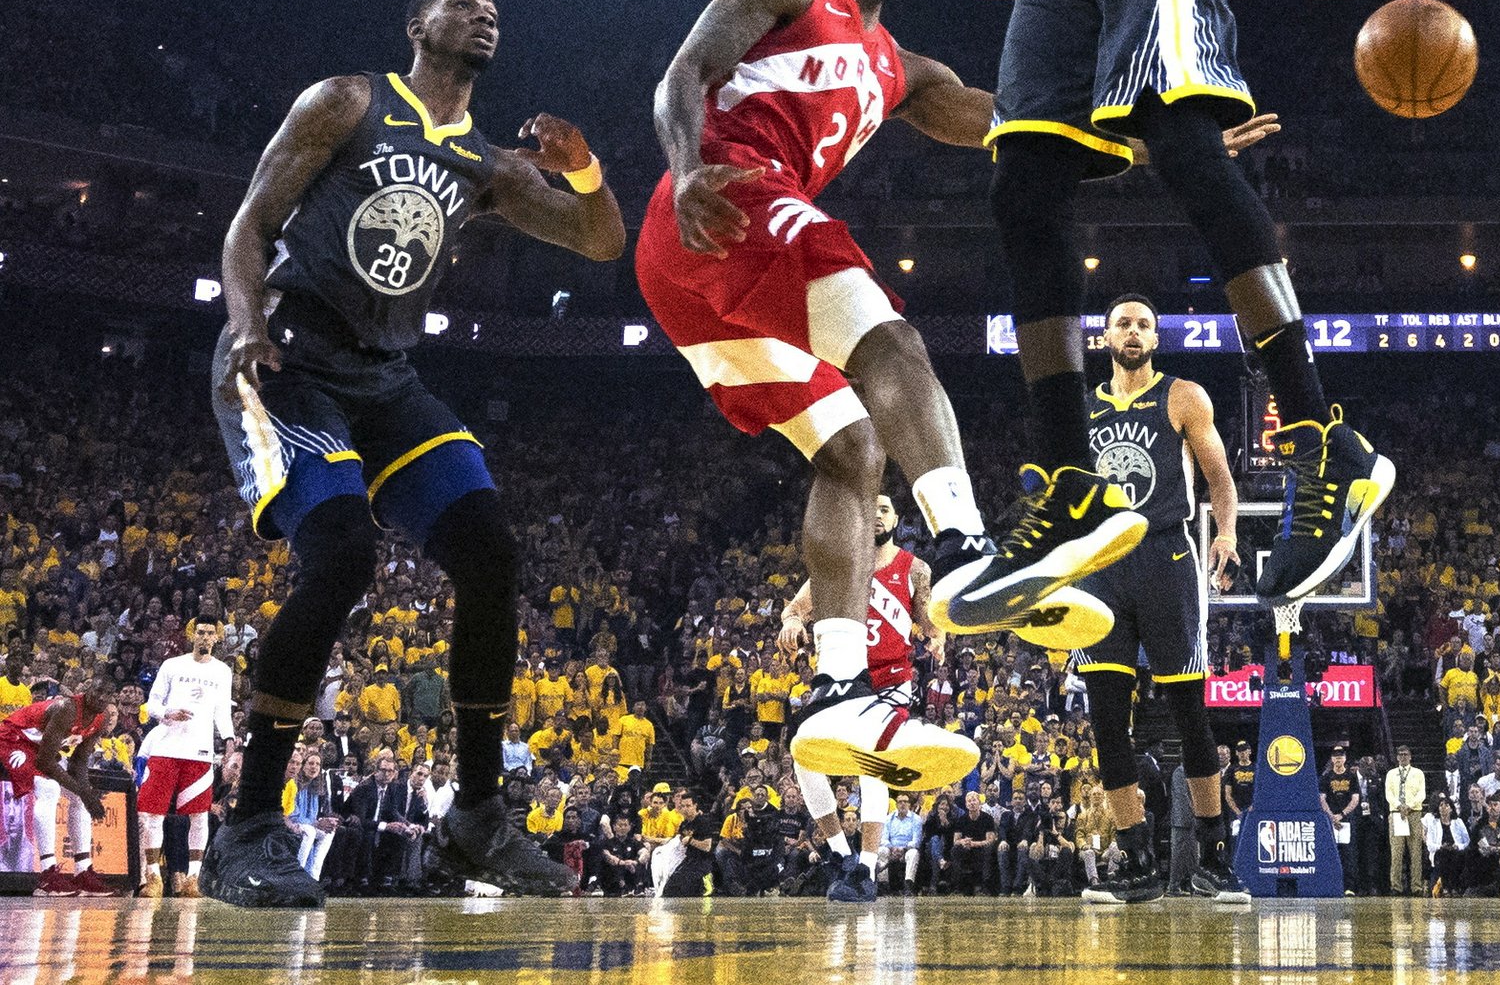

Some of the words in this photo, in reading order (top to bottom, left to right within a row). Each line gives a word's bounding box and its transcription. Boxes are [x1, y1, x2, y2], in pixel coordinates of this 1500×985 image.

[373, 143, 395, 155] The
[359, 154, 464, 217] TOWN
[369, 243, 412, 288] 28
[1183, 320, 1222, 348] 21
[1313, 319, 1352, 347] 12
[1379, 333, 1389, 348] 2
[1407, 333, 1418, 348] 6
[1435, 333, 1446, 348] 4
[1463, 333, 1473, 348] 2
[1489, 333, 1500, 348] 0
[1375, 315, 1389, 325] TF
[1402, 315, 1423, 325] TOL
[1429, 315, 1450, 325] REB
[1456, 315, 1478, 325] AST
[1089, 421, 1158, 454] TOWN
[870, 587, 901, 620] RTH
[866, 619, 883, 647] 3
[1278, 821, 1301, 842] NBA
[1278, 842, 1316, 862] FINALS
